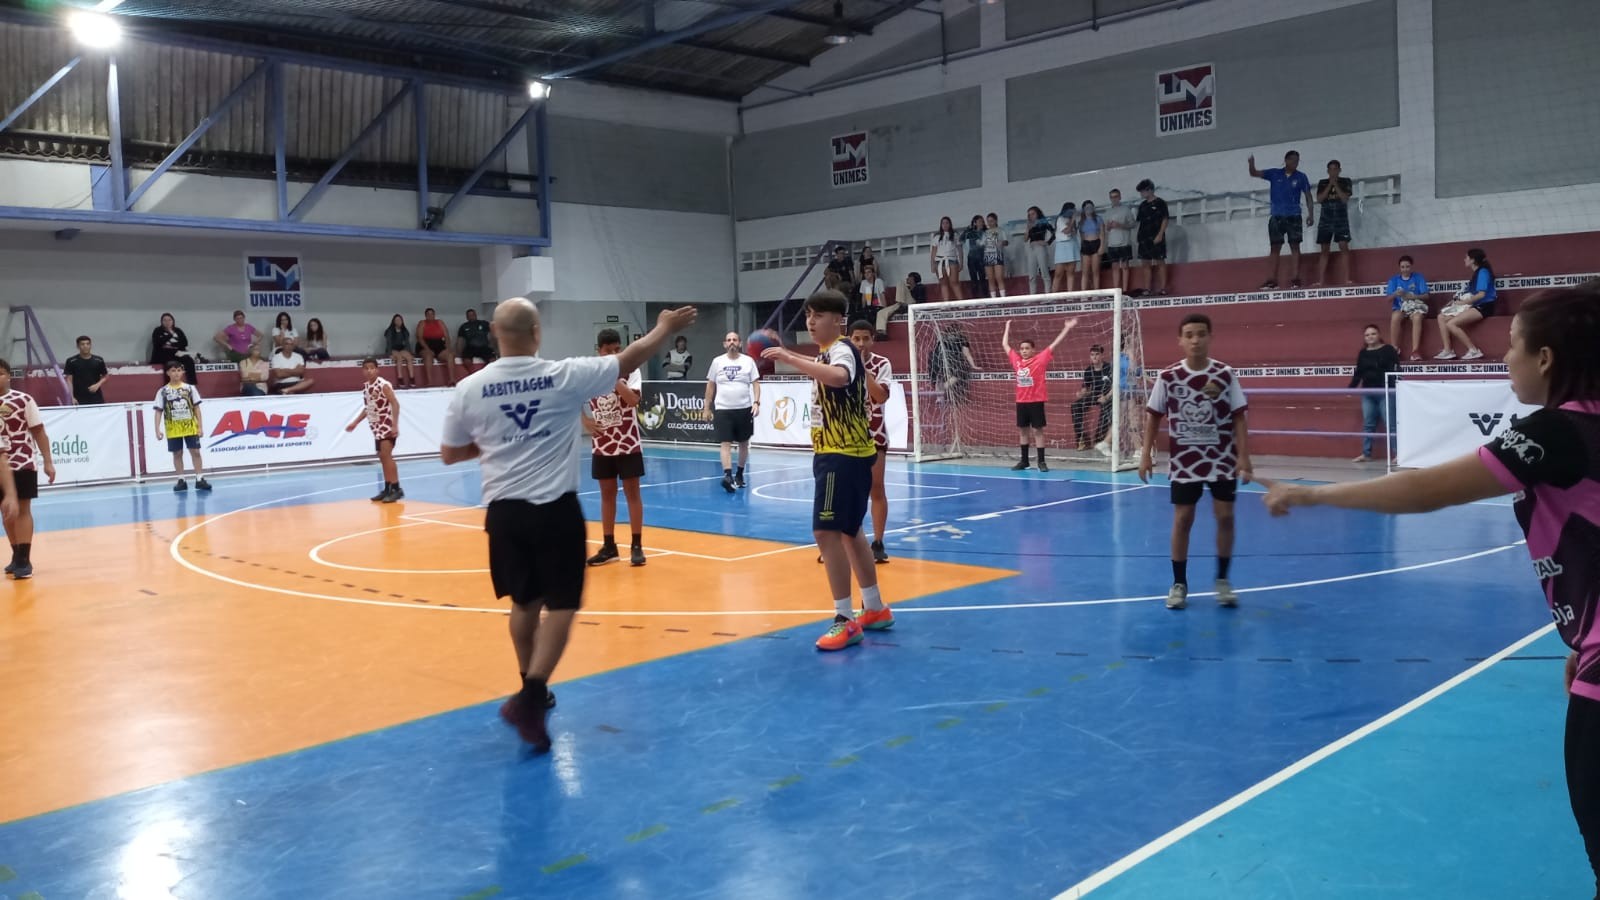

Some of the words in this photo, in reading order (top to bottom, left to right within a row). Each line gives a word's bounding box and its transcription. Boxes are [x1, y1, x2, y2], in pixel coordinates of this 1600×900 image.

[1159, 109, 1213, 132] UNIMES
[832, 168, 867, 186] UNIMES
[249, 293, 302, 307] UNIMES
[1247, 293, 1270, 301] UNIMES
[1282, 291, 1306, 299] UNIMES
[1317, 289, 1342, 298] UNIMES
[1355, 287, 1381, 296] UNIMES
[1434, 282, 1462, 291] UNIMES
[1520, 277, 1551, 287] UNIMES
[1239, 368, 1263, 376] UNIMES
[1275, 367, 1301, 376] UNIMES
[1314, 367, 1340, 375] UNIMES
[1438, 364, 1467, 372] UNIMES
[1483, 364, 1510, 372] UNIME
[481, 375, 555, 399] ARBITRAGEM
[666, 392, 705, 409] Douto
[210, 410, 311, 439] ANE
[51, 434, 89, 456] aúde
[210, 445, 246, 453] ASSOCIAÇÃO
[1551, 602, 1575, 626] oja
